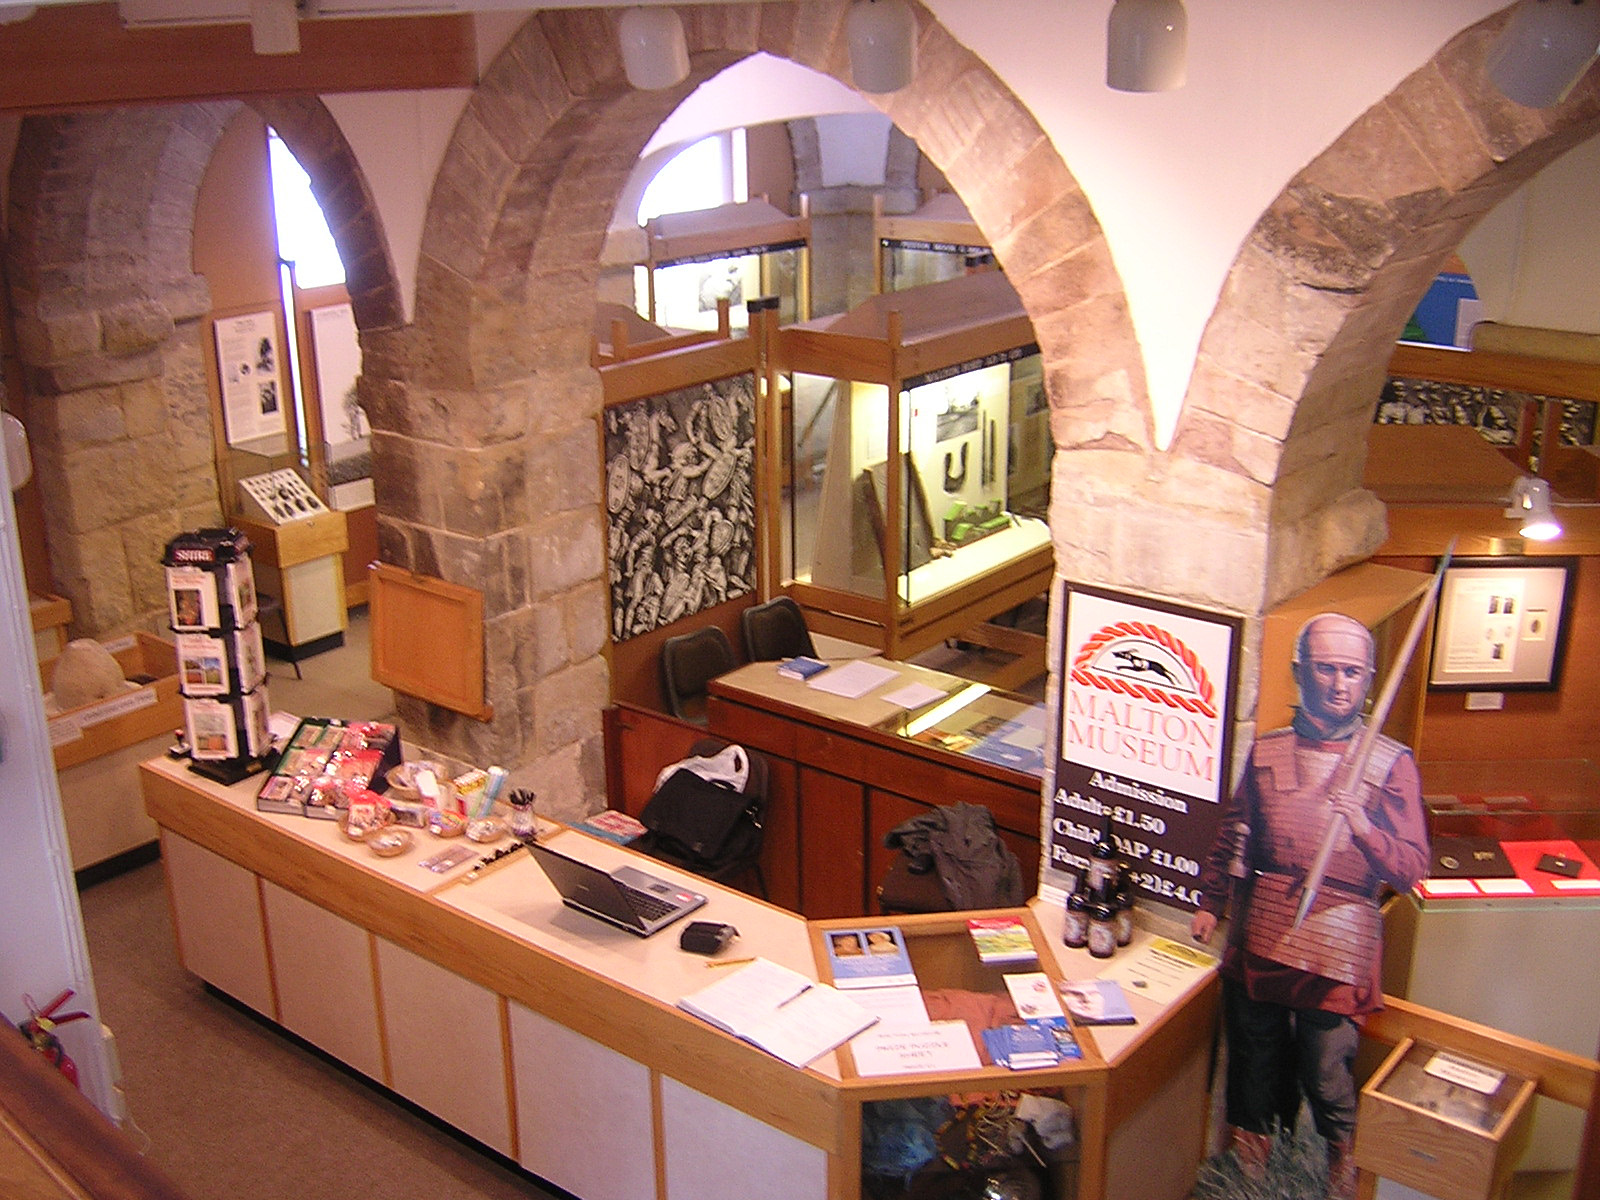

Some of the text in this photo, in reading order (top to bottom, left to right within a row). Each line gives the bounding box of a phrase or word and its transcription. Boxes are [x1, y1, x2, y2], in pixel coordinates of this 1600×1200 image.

[1070, 690, 1215, 750] MALTON
[1068, 719, 1215, 782] MUSEUM
[1088, 771, 1188, 814] Admission
[1111, 805, 1166, 835] £1.50
[1150, 849, 1200, 877] £1.00
